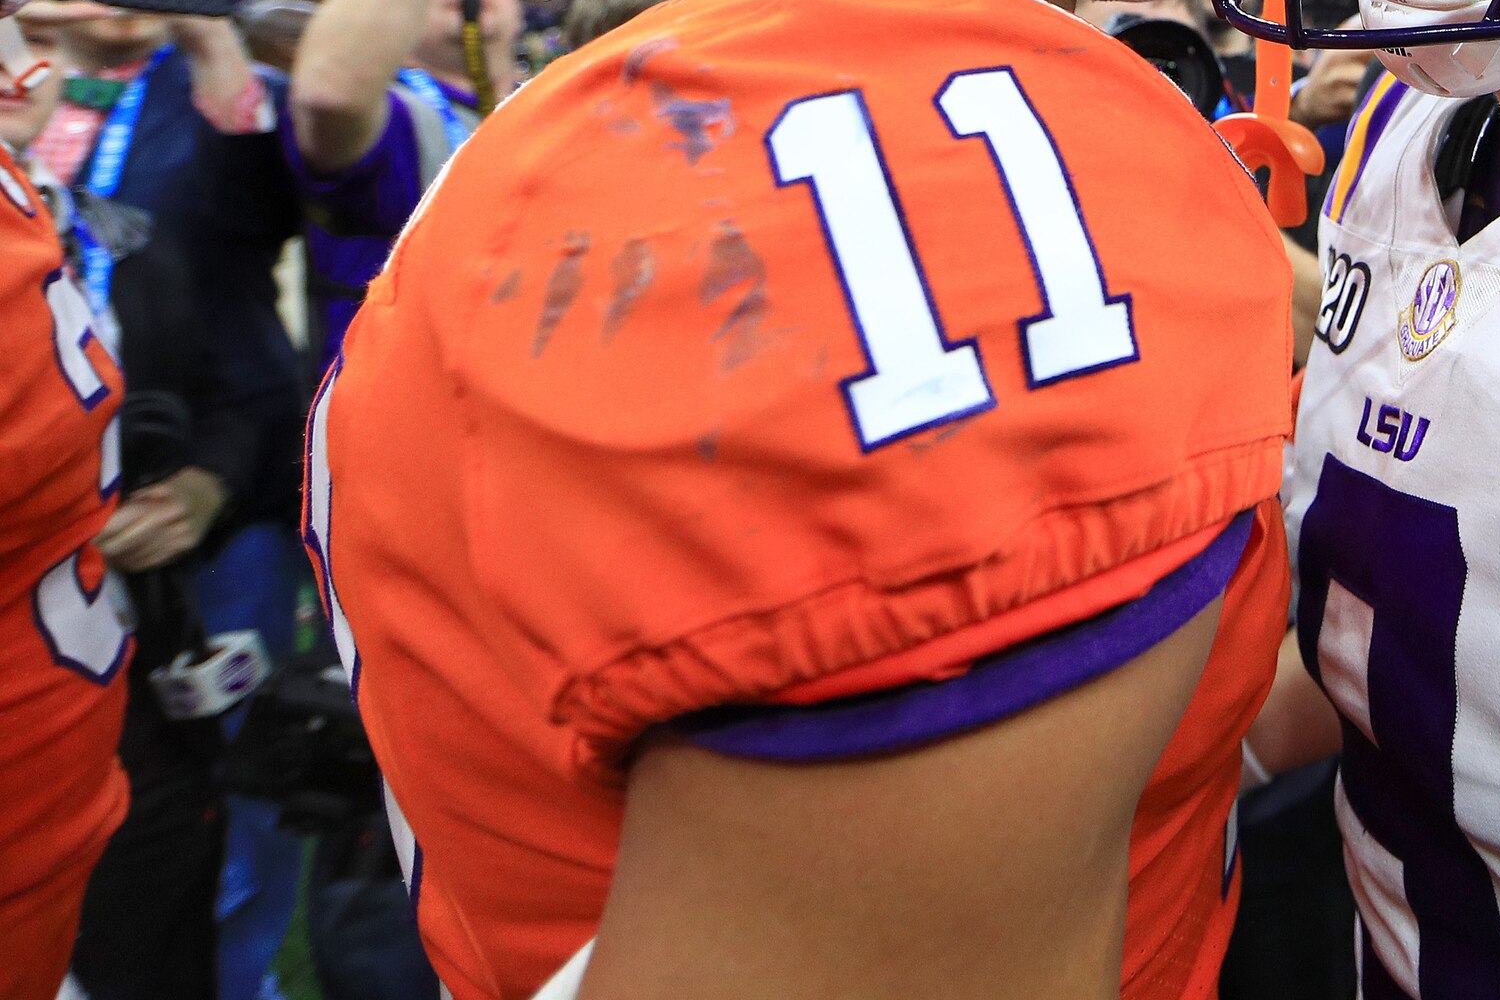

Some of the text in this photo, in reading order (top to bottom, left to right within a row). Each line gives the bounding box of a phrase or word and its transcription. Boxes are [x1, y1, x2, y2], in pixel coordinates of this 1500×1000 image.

[764, 65, 1140, 454] 11
[1400, 323, 1440, 357] GRADUATE
[1356, 396, 1431, 462] LSU
